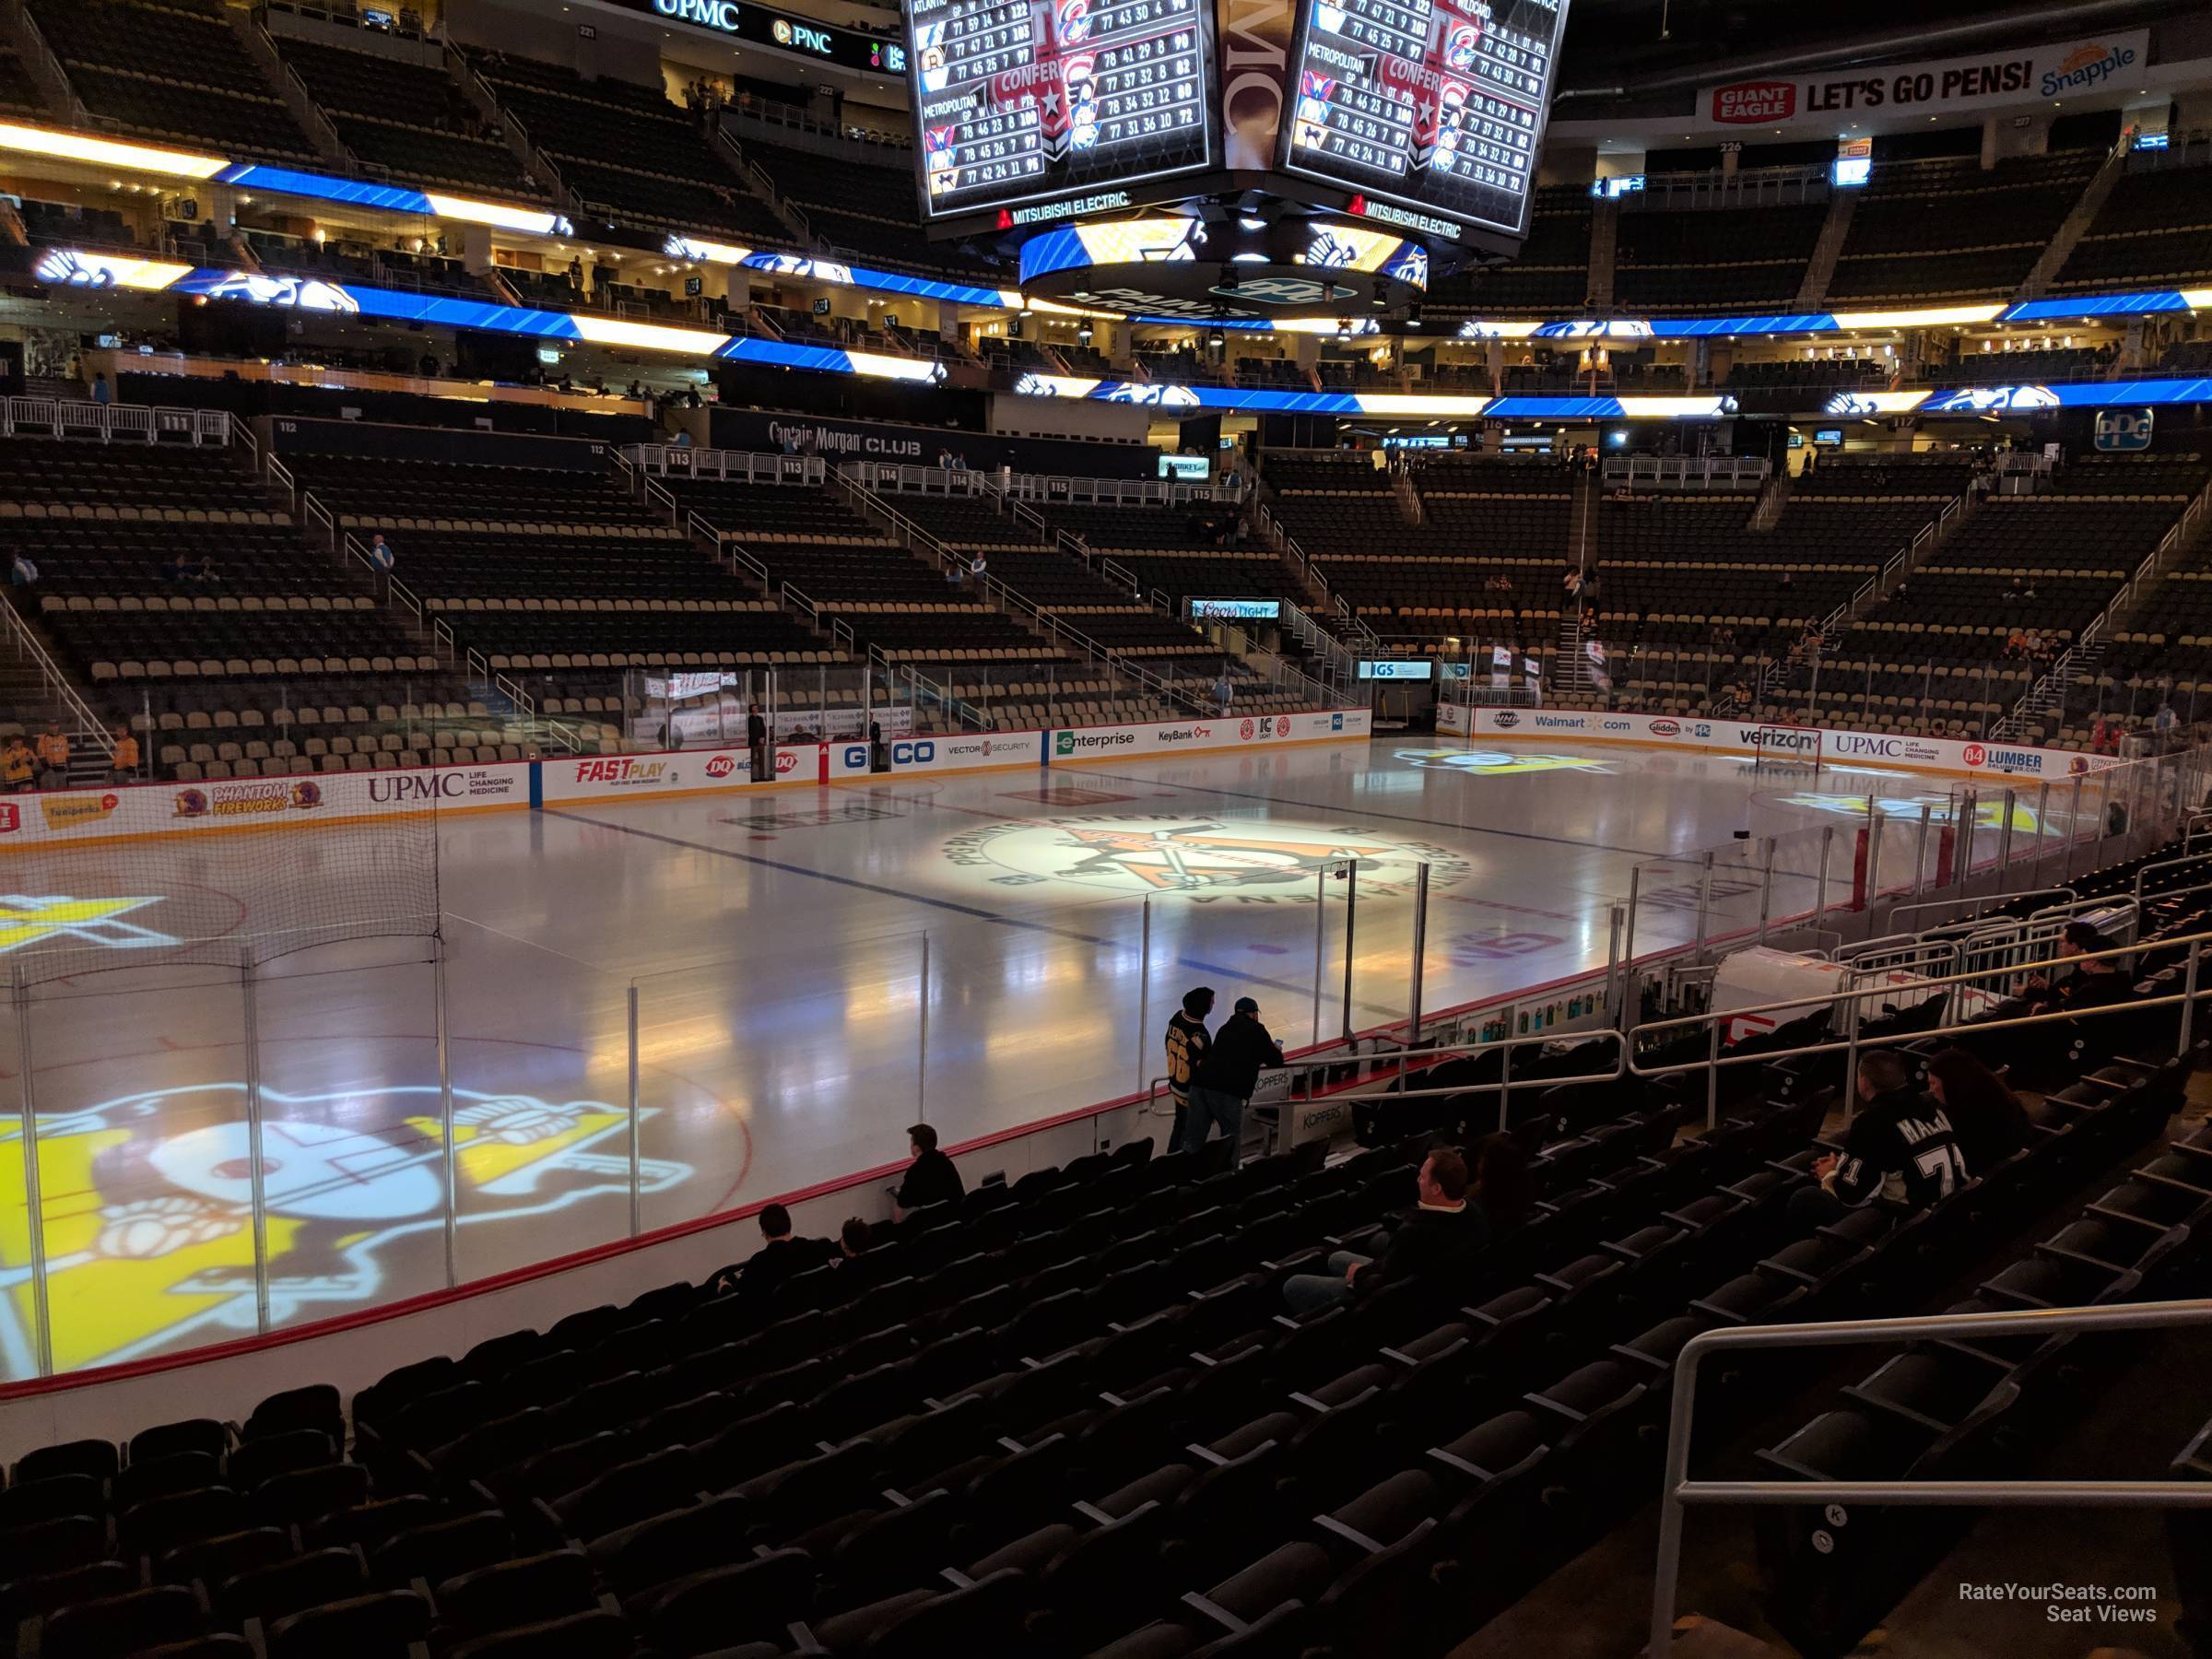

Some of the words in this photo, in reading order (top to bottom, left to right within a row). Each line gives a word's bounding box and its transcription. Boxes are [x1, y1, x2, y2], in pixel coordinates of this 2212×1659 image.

[657, 0, 739, 30] UPMC
[1102, 15, 1113, 29] 77
[1120, 10, 1132, 25] 43
[1135, 6, 1147, 21] 30
[954, 22, 962, 36] 77
[969, 18, 979, 30] 59
[982, 14, 992, 27] 14
[793, 25, 832, 53] PNC
[956, 43, 964, 57] 77
[971, 39, 980, 52] 47
[985, 35, 994, 48] 21
[1105, 53, 1116, 67] 78
[1123, 48, 1134, 63] 41
[1139, 43, 1150, 59] 29
[1308, 41, 1365, 74] METROPOLITAN
[958, 65, 967, 80] 77
[973, 61, 982, 75] 45
[987, 58, 996, 72] 25
[2041, 46, 2136, 98] Snapple
[1107, 76, 1117, 91] 77
[1124, 72, 1135, 88] 37
[1141, 68, 1152, 84] 32
[1806, 78, 1885, 112] LET'S
[1892, 73, 1934, 104] GO
[1940, 61, 2034, 99] PENS!
[1108, 100, 1120, 115] 78
[1125, 97, 1137, 111] 34
[1142, 92, 1154, 108] 32
[1159, 88, 1170, 103] 12
[1341, 88, 1353, 104] 78
[1357, 94, 1368, 110] 46
[1721, 87, 1789, 104] GIANT
[924, 94, 977, 118] METROPOLITAN
[1721, 102, 1785, 118] EAGLE
[962, 125, 973, 138] 78
[979, 123, 989, 135] 46
[993, 119, 1002, 132] 23
[1111, 124, 1121, 138] 77
[1128, 121, 1139, 135] 31
[1160, 112, 1171, 128] 10
[1337, 113, 1348, 129] 78
[1353, 119, 1364, 134] 45
[965, 148, 975, 161] 78
[981, 145, 990, 158] 45
[994, 142, 1004, 155] 26
[1335, 138, 1346, 153] 77
[1349, 144, 1360, 158] 42
[1720, 142, 1743, 153] 226
[968, 170, 977, 183] 77
[982, 167, 992, 180] 42
[1013, 201, 1071, 225] MITSUBISHI
[1074, 193, 1130, 214] ELECTRIC
[1366, 201, 1418, 229] MITSUBISHI
[1419, 216, 1462, 239] ELECTRIC
[1095, 288, 1261, 315] PAINS
[164, 416, 188, 430] 111
[280, 421, 297, 433] 112
[1483, 419, 1503, 429] 116
[2098, 415, 2150, 446] PPG
[590, 445, 605, 454] 112
[815, 427, 861, 454] Morgan
[865, 438, 921, 456] CLUB
[670, 453, 689, 465] 113
[784, 463, 802, 474] 113
[880, 469, 897, 481] 114
[953, 475, 967, 486] 114
[1050, 482, 1067, 492] 115
[1194, 490, 1210, 500] 115
[1203, 602, 1238, 618] Coors
[1239, 605, 1269, 618] LIGHT
[1372, 664, 1394, 677] IGS
[1260, 717, 1272, 733] IC
[1535, 716, 1584, 728] Walmart
[1604, 720, 1630, 731] com
[1649, 722, 1681, 735] Glidden
[1060, 733, 1135, 748] enterprise
[1159, 730, 1193, 742] KeyBank
[1740, 730, 1812, 749] verizon
[948, 746, 981, 754] VECTOR
[993, 742, 1030, 752] SECURITY
[1836, 735, 1902, 758] UPMC
[1905, 747, 1940, 755] CHANGING
[711, 759, 731, 772] DQ
[776, 756, 794, 769] DQ
[1965, 745, 1983, 762] 84
[1987, 749, 2042, 769] LUMBER
[469, 771, 487, 780] LIFE
[575, 759, 634, 782] FAST
[629, 762, 666, 779] PLAY
[213, 782, 288, 801] PHANTOM
[369, 772, 465, 803] UPMC
[469, 778, 513, 787] CHANGING
[470, 786, 510, 795] MEDICINE
[213, 797, 288, 816] FIREWORKS
[1048, 814, 1218, 826] ARENA
[1303, 1107, 1342, 1130] KOPPERS
